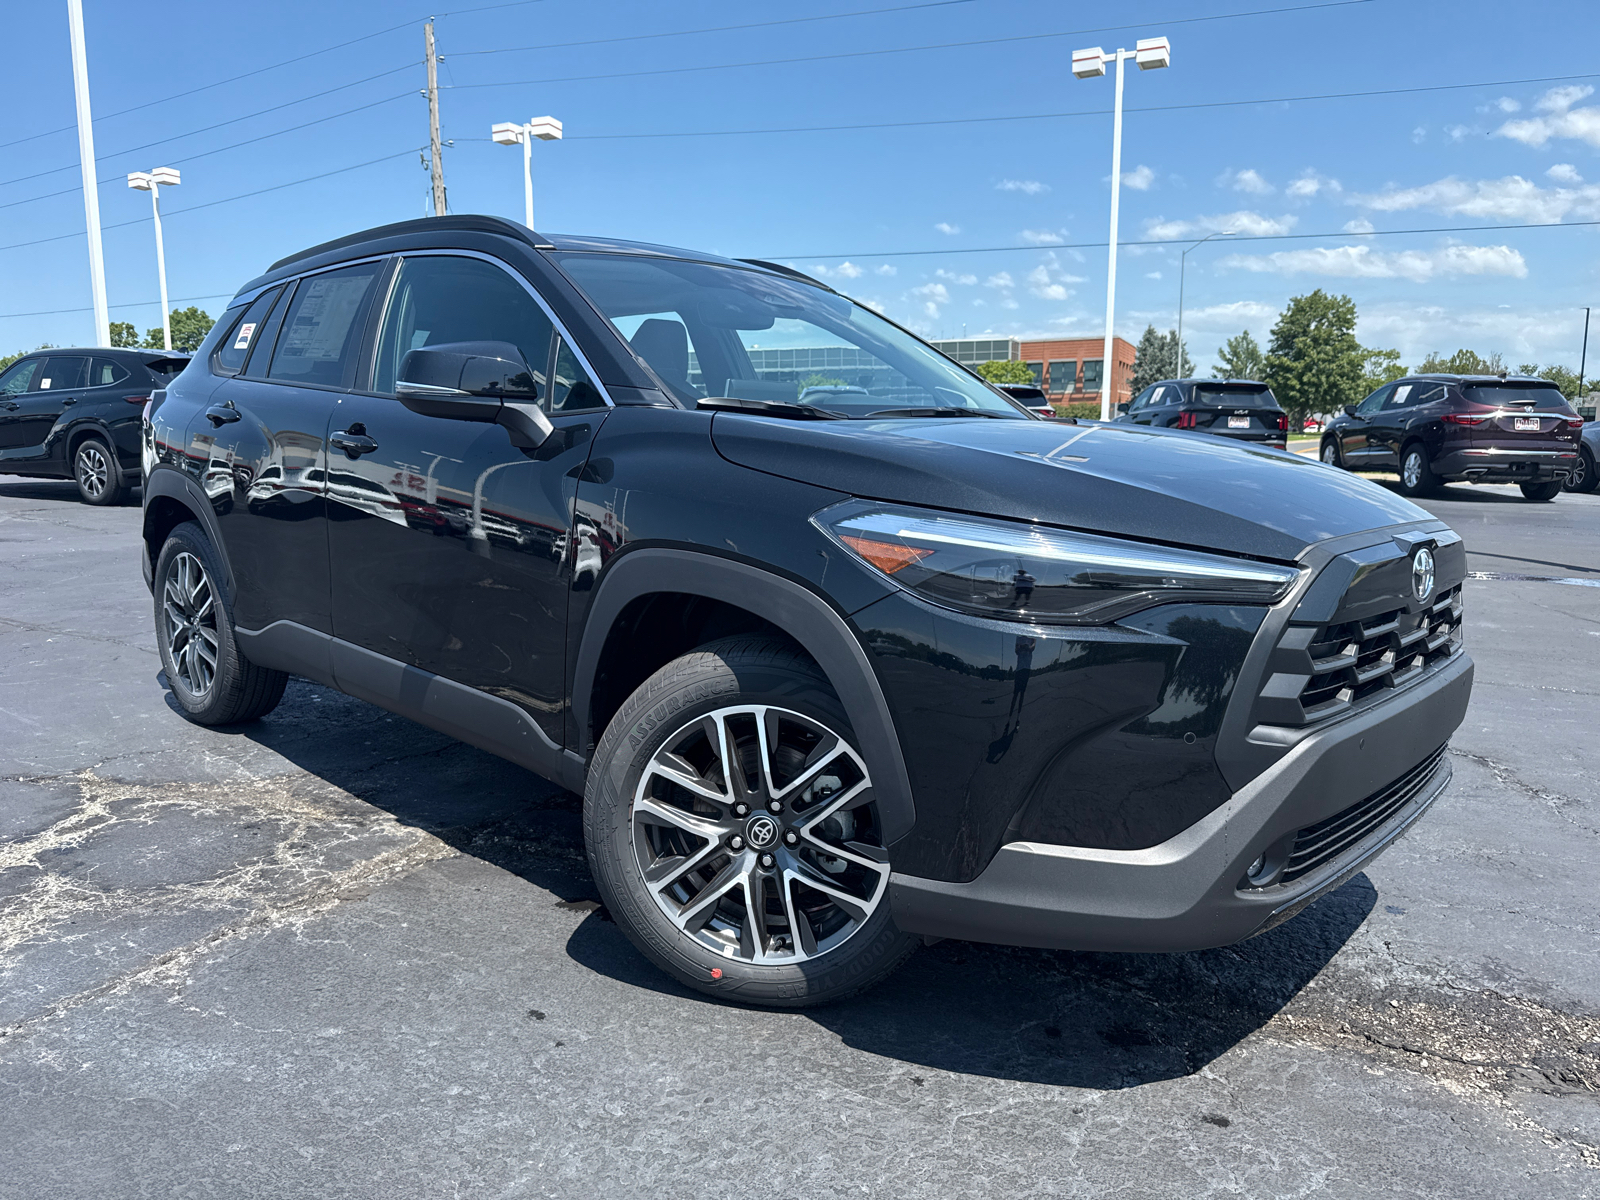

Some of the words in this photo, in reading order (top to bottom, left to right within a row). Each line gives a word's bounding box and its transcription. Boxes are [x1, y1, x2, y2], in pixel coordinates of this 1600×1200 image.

[1516, 419, 1538, 428] ADAMS
[627, 679, 737, 752] ASSURANCE
[777, 930, 895, 998] GOODYEAR
